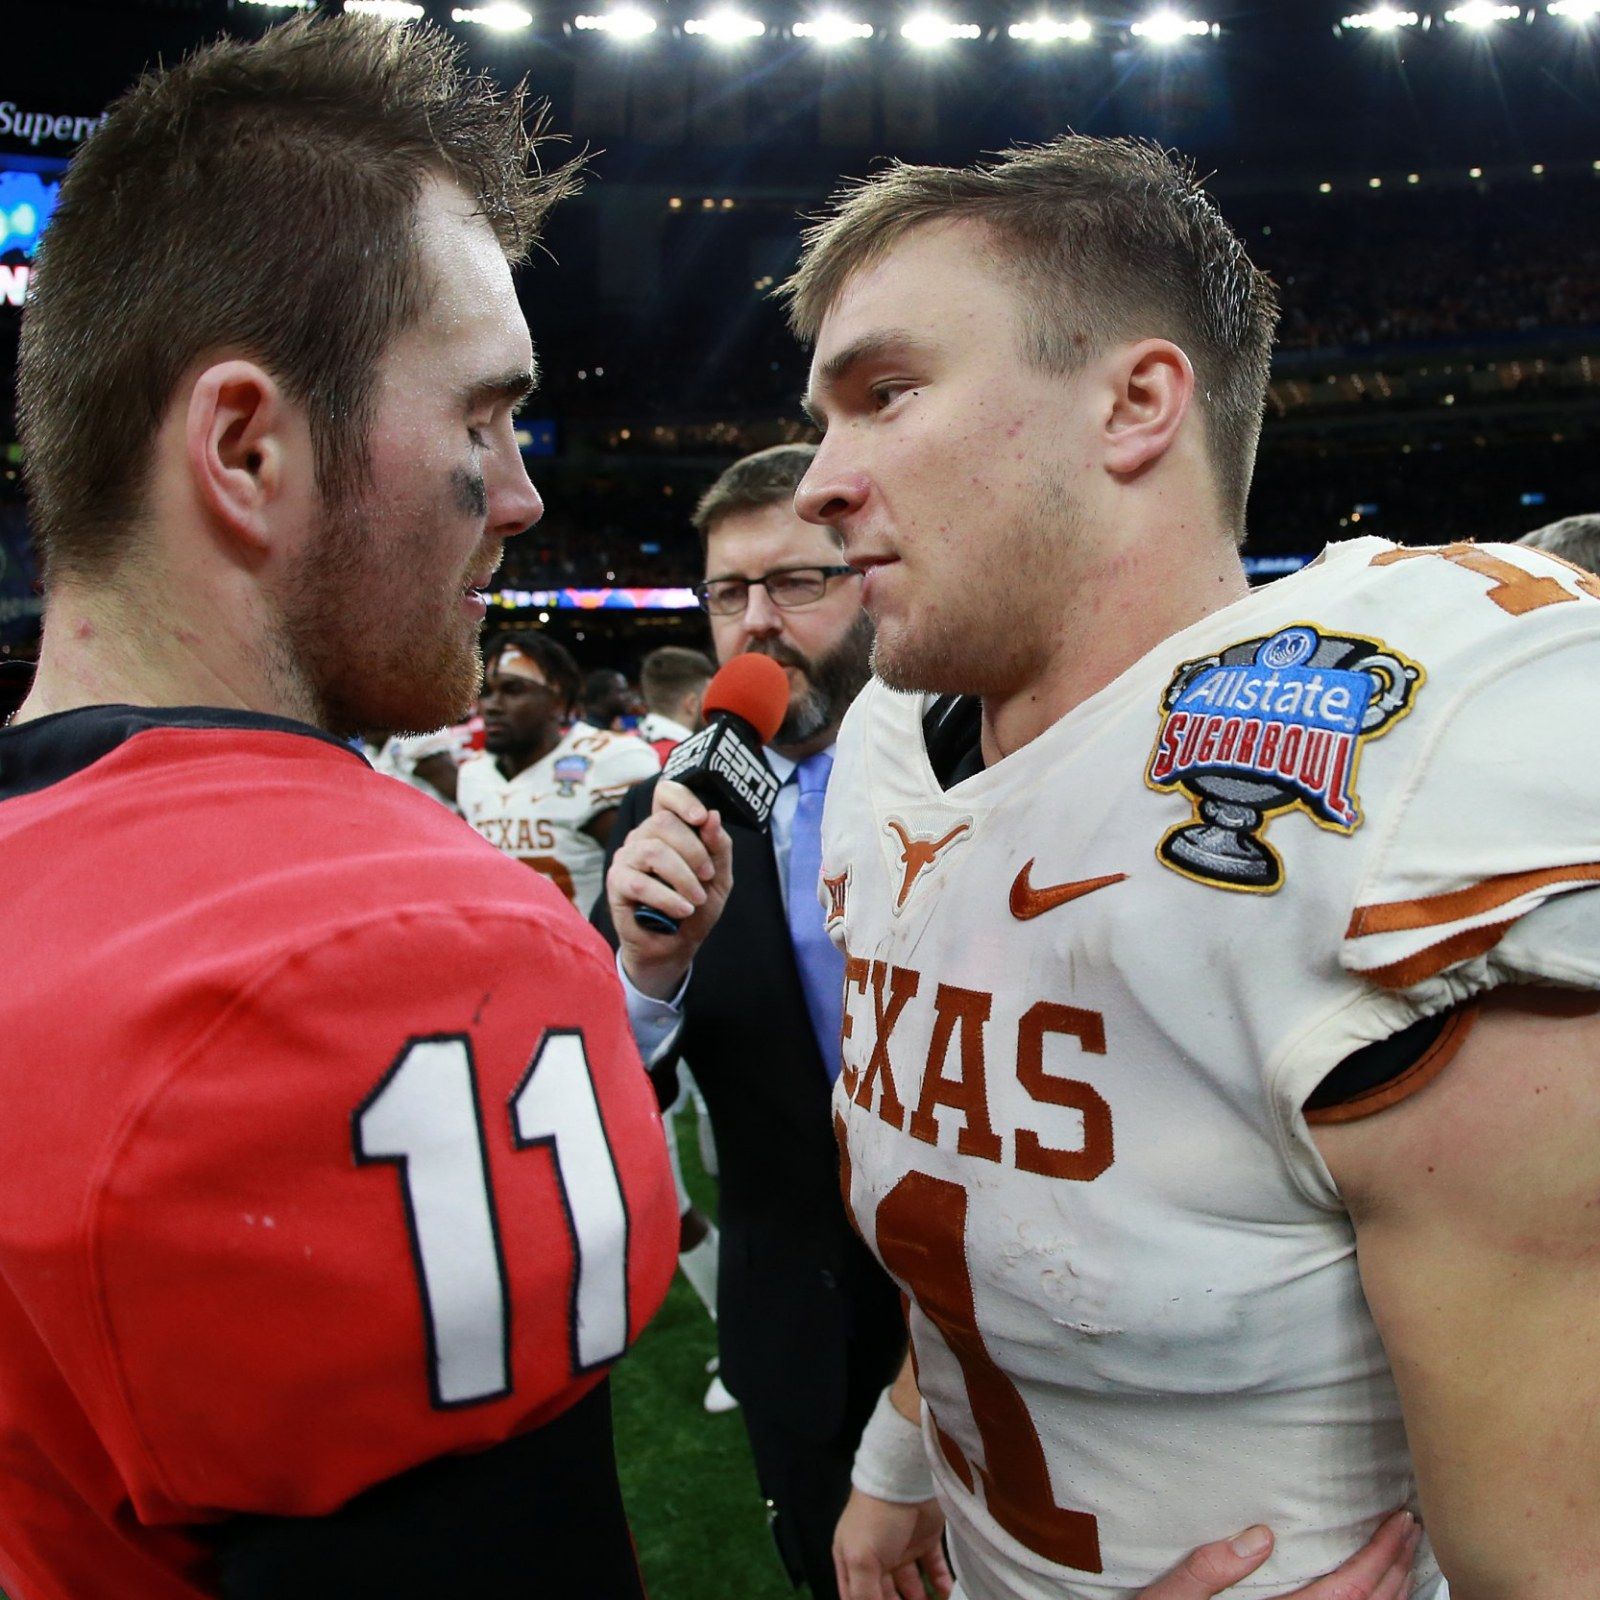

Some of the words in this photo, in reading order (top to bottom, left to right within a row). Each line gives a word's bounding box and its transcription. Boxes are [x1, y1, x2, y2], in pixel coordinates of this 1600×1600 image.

[1184, 669, 1352, 722] Allstate
[716, 727, 779, 807] ESPN
[350, 1026, 631, 1411] 11
